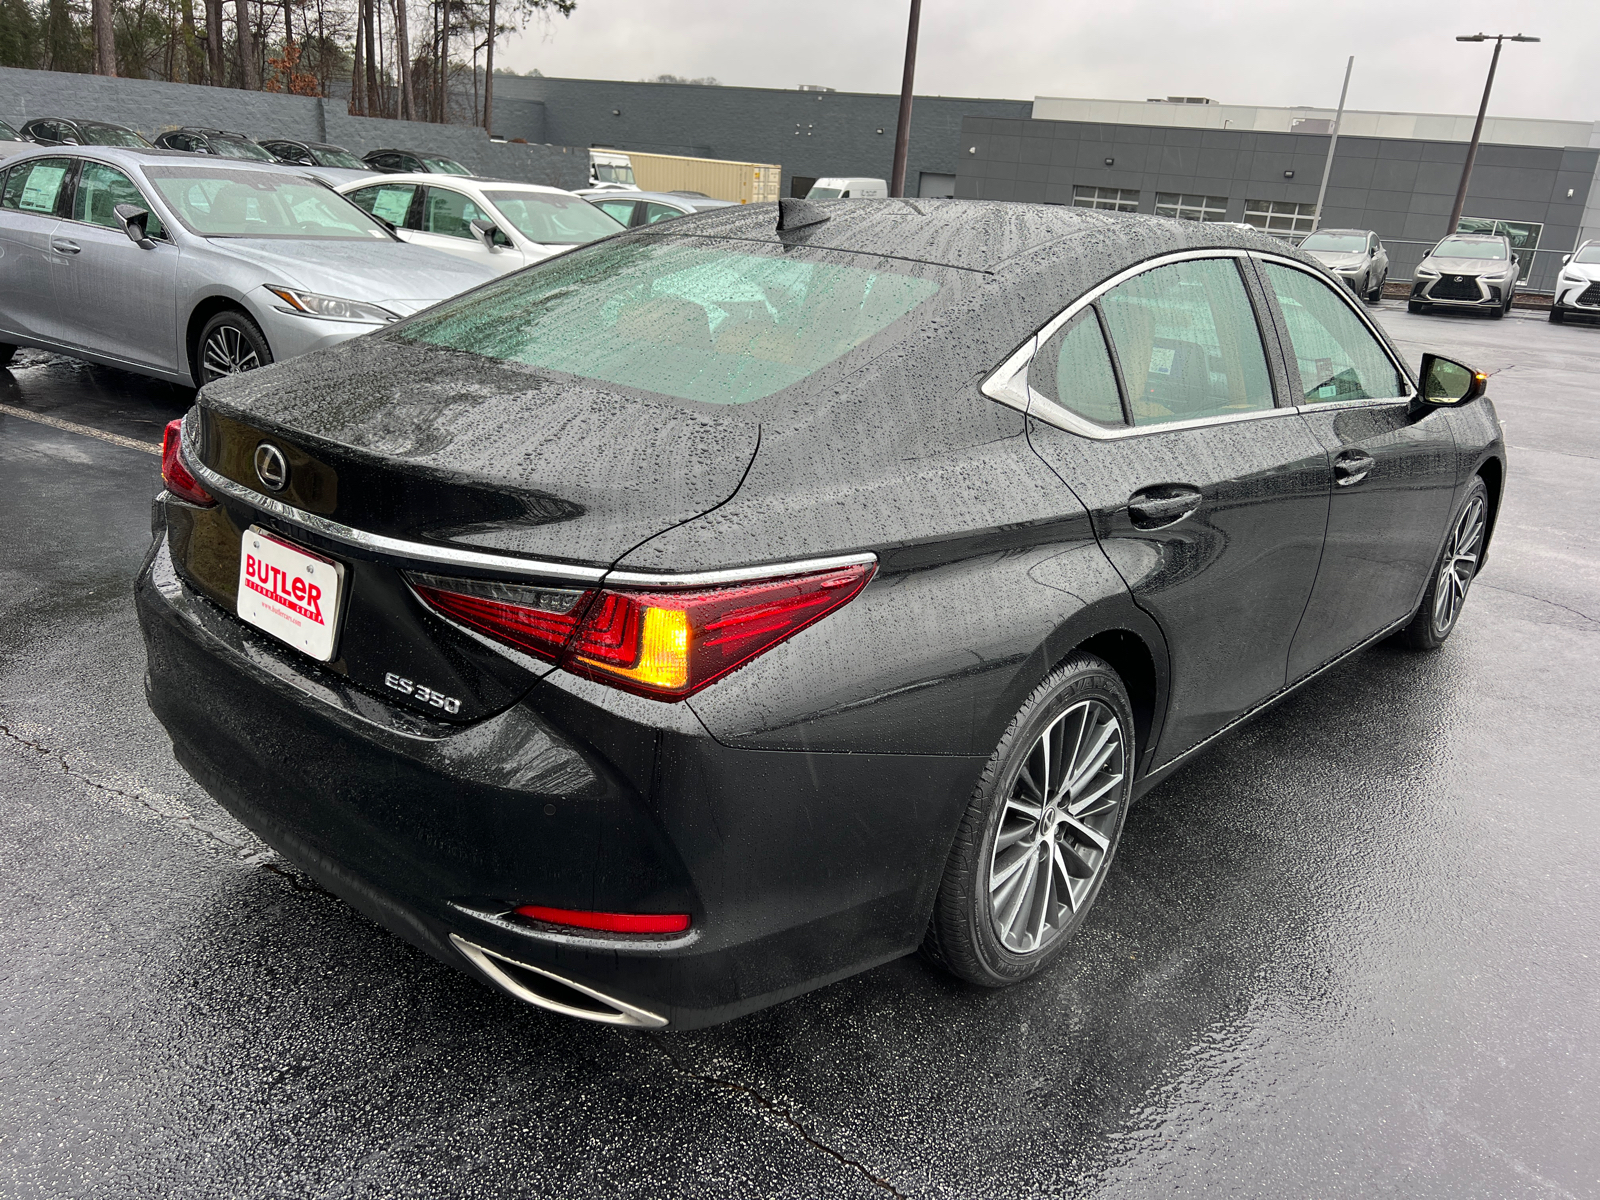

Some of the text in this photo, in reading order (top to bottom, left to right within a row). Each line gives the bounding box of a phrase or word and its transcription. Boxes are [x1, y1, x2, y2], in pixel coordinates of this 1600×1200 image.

[261, 601, 302, 628] www.butlercars.com
[296, 605, 322, 623] GROUP
[384, 672, 462, 715] ES 350
